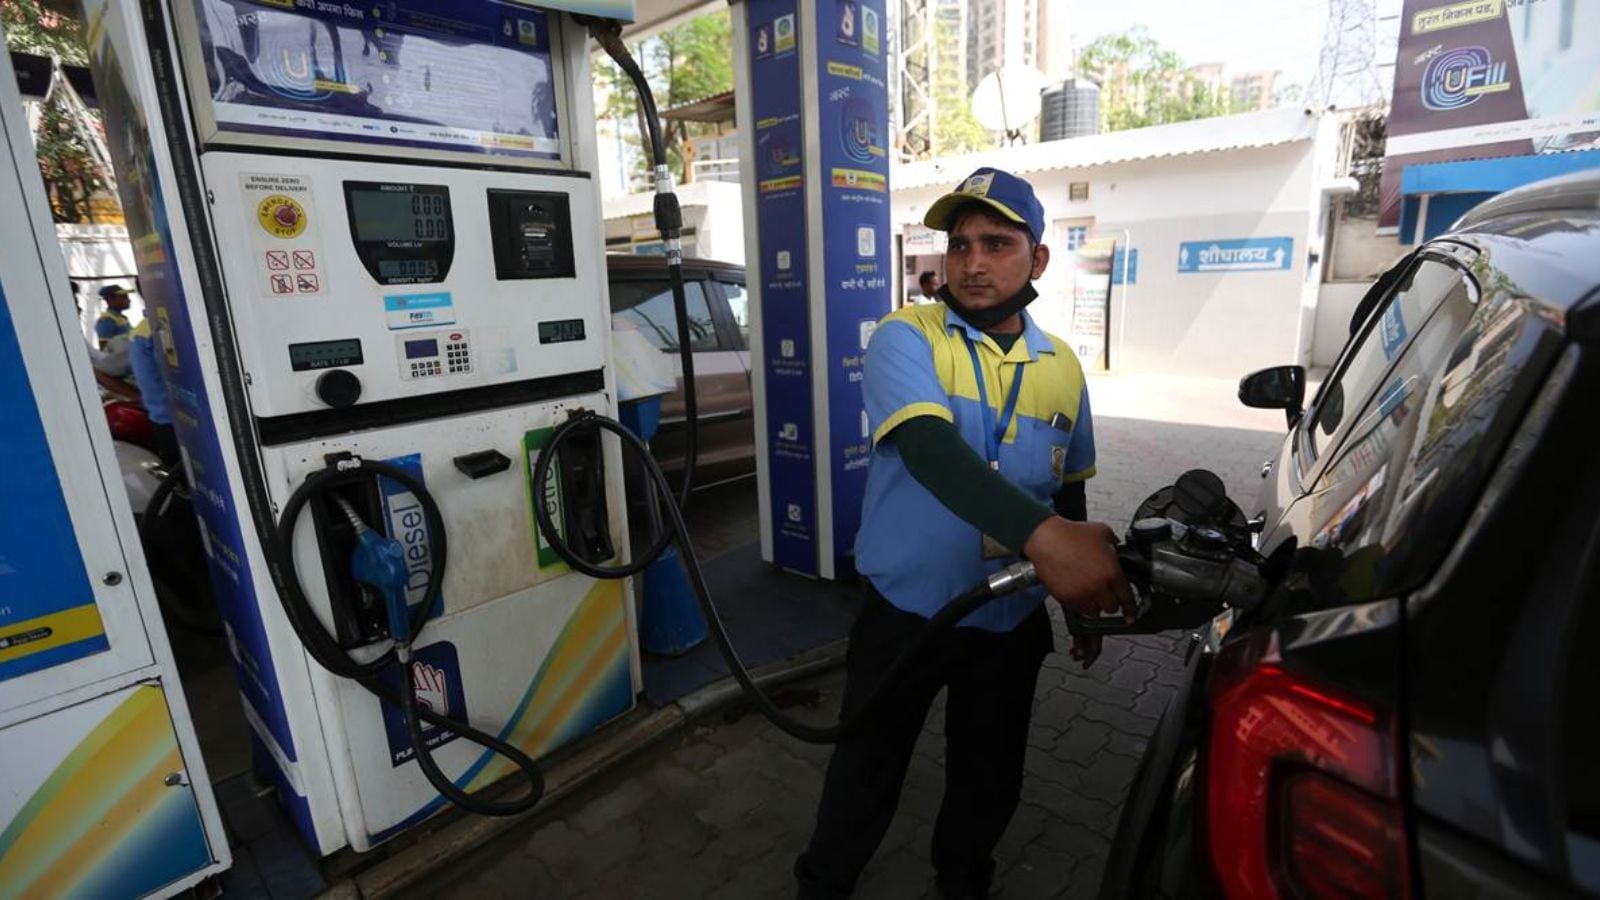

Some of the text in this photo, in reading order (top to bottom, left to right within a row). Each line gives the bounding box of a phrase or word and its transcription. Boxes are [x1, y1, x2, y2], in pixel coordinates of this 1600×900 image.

[281, 177, 300, 185] ZERO
[380, 184, 408, 192] AMOUNT
[275, 227, 297, 236] STOP
[393, 503, 432, 591] Diesel
